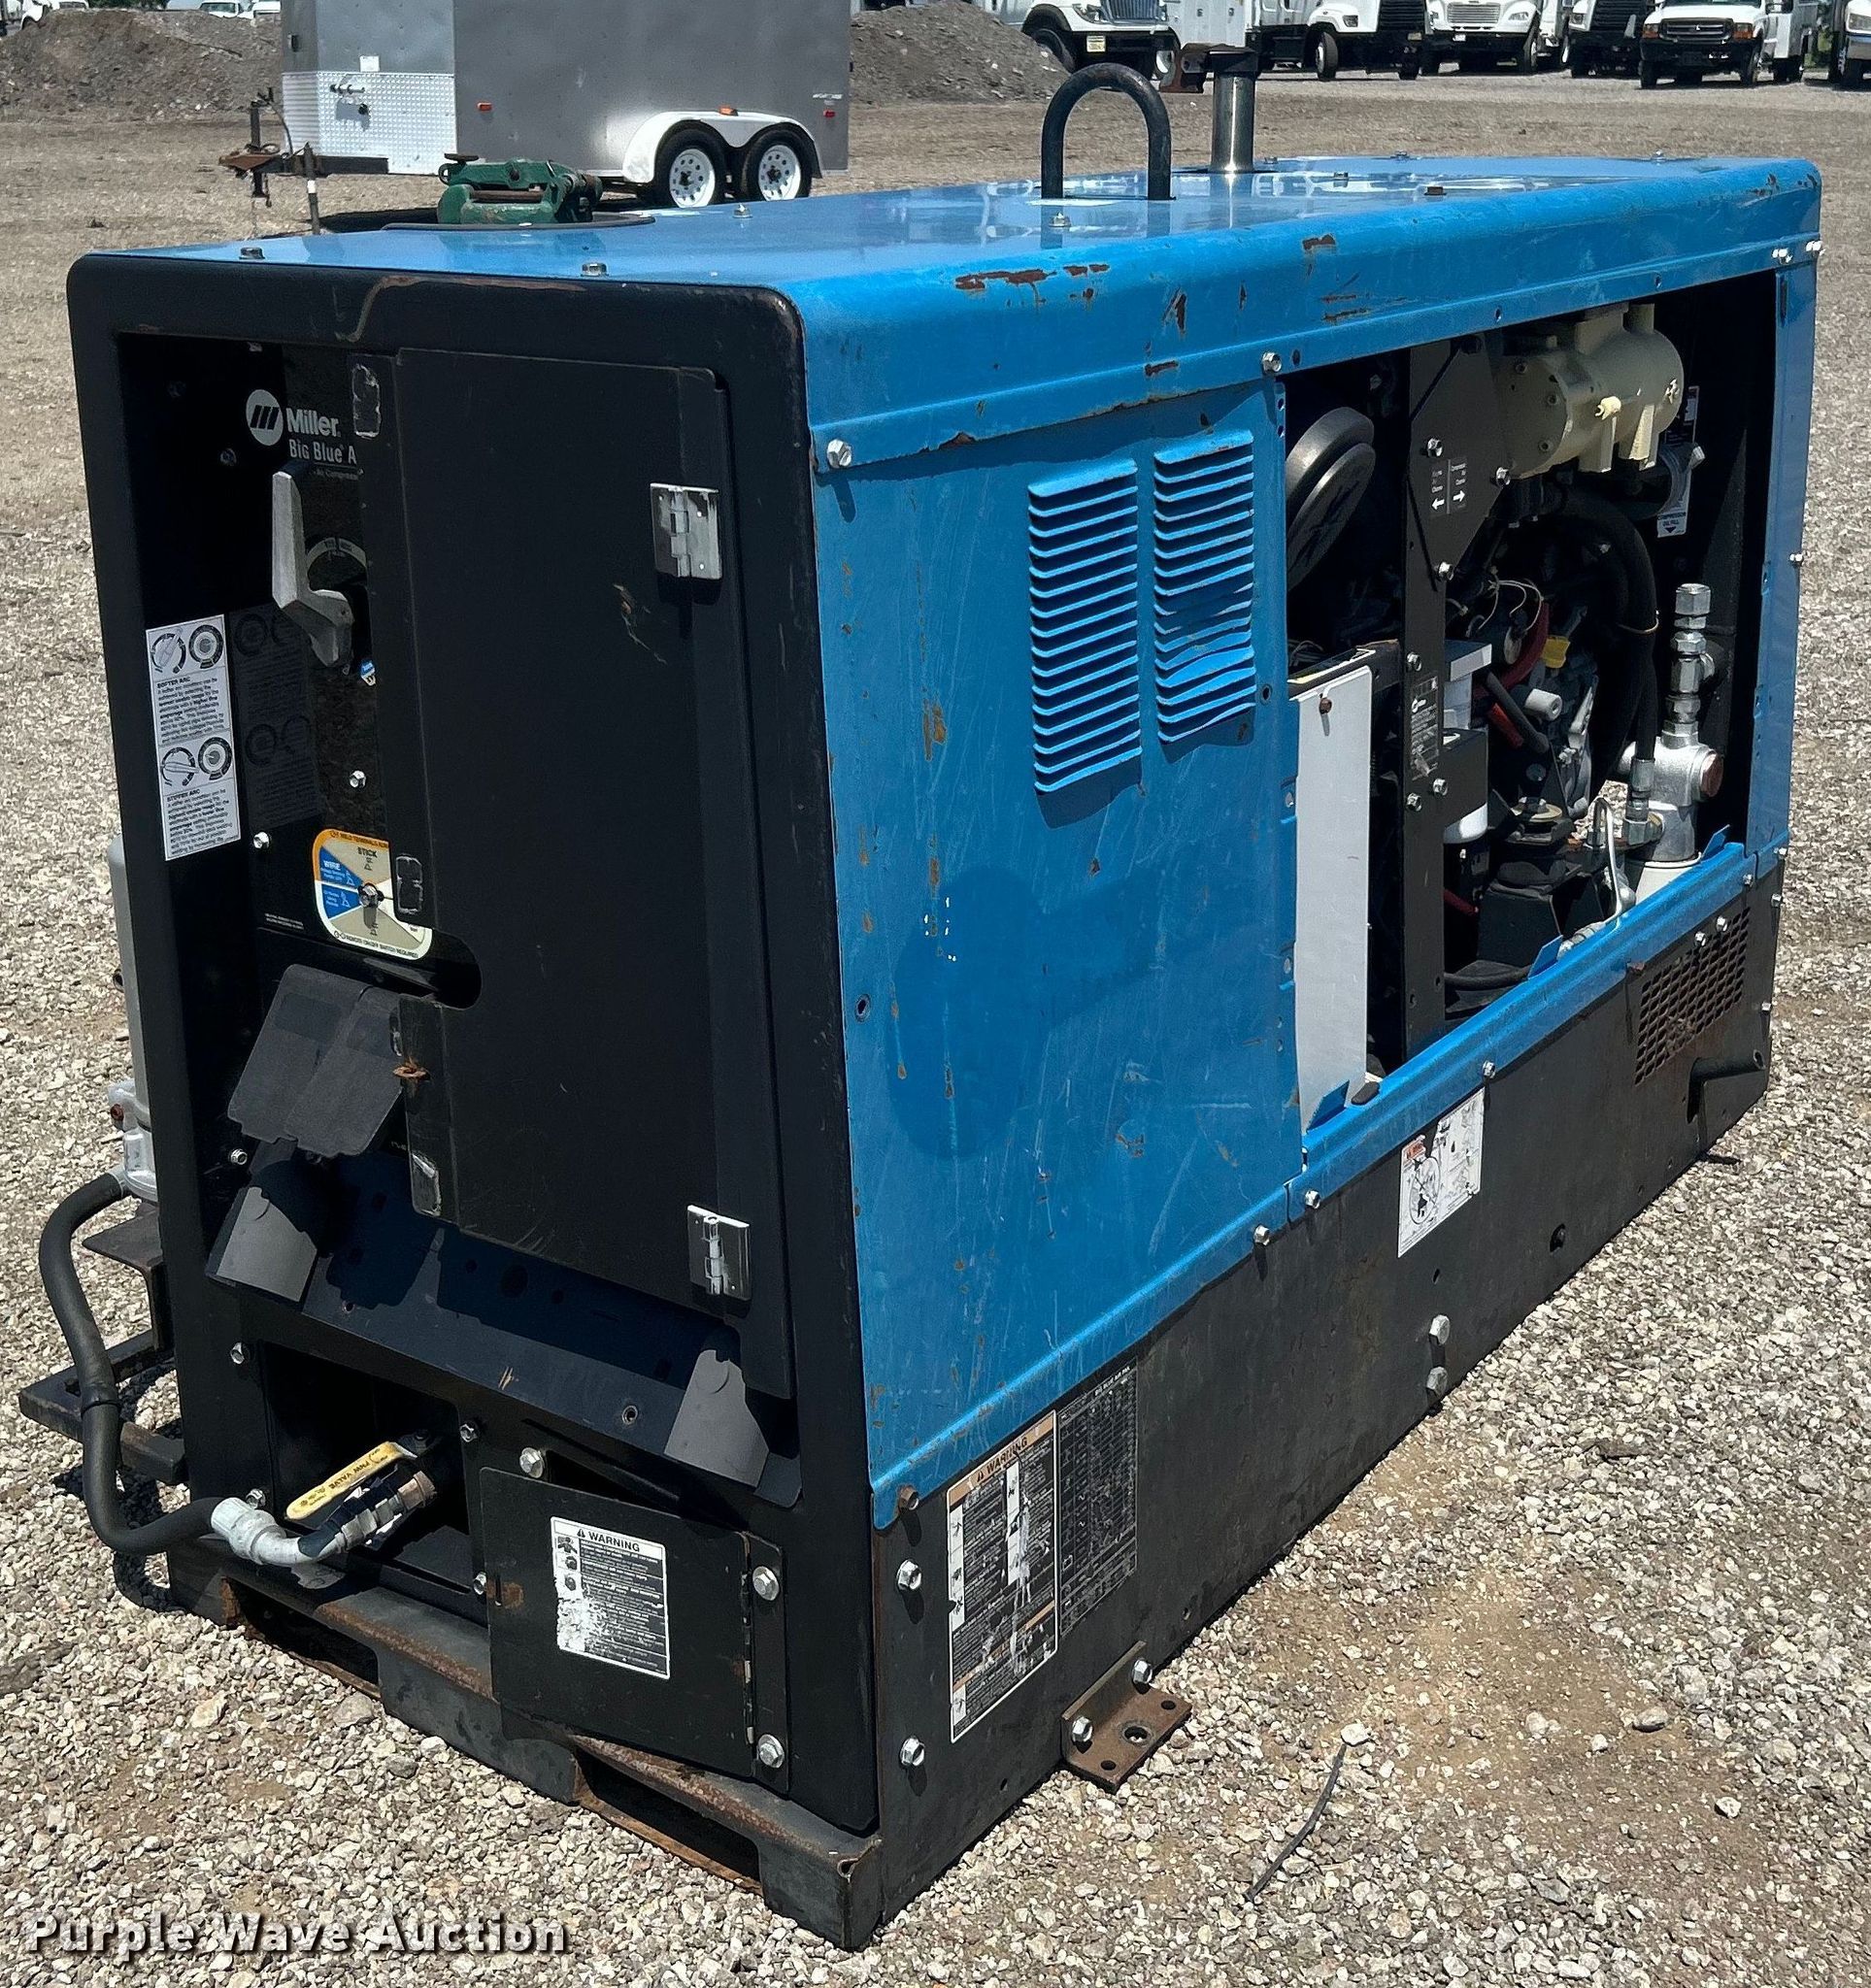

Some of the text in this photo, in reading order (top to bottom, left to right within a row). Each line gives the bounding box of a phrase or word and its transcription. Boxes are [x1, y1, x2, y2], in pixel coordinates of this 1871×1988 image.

[285, 408, 340, 437] Miller
[313, 441, 343, 463] Blue
[357, 846, 378, 858] STICK
[986, 1437, 1028, 1474] WARNING
[588, 1530, 640, 1552] WARNING
